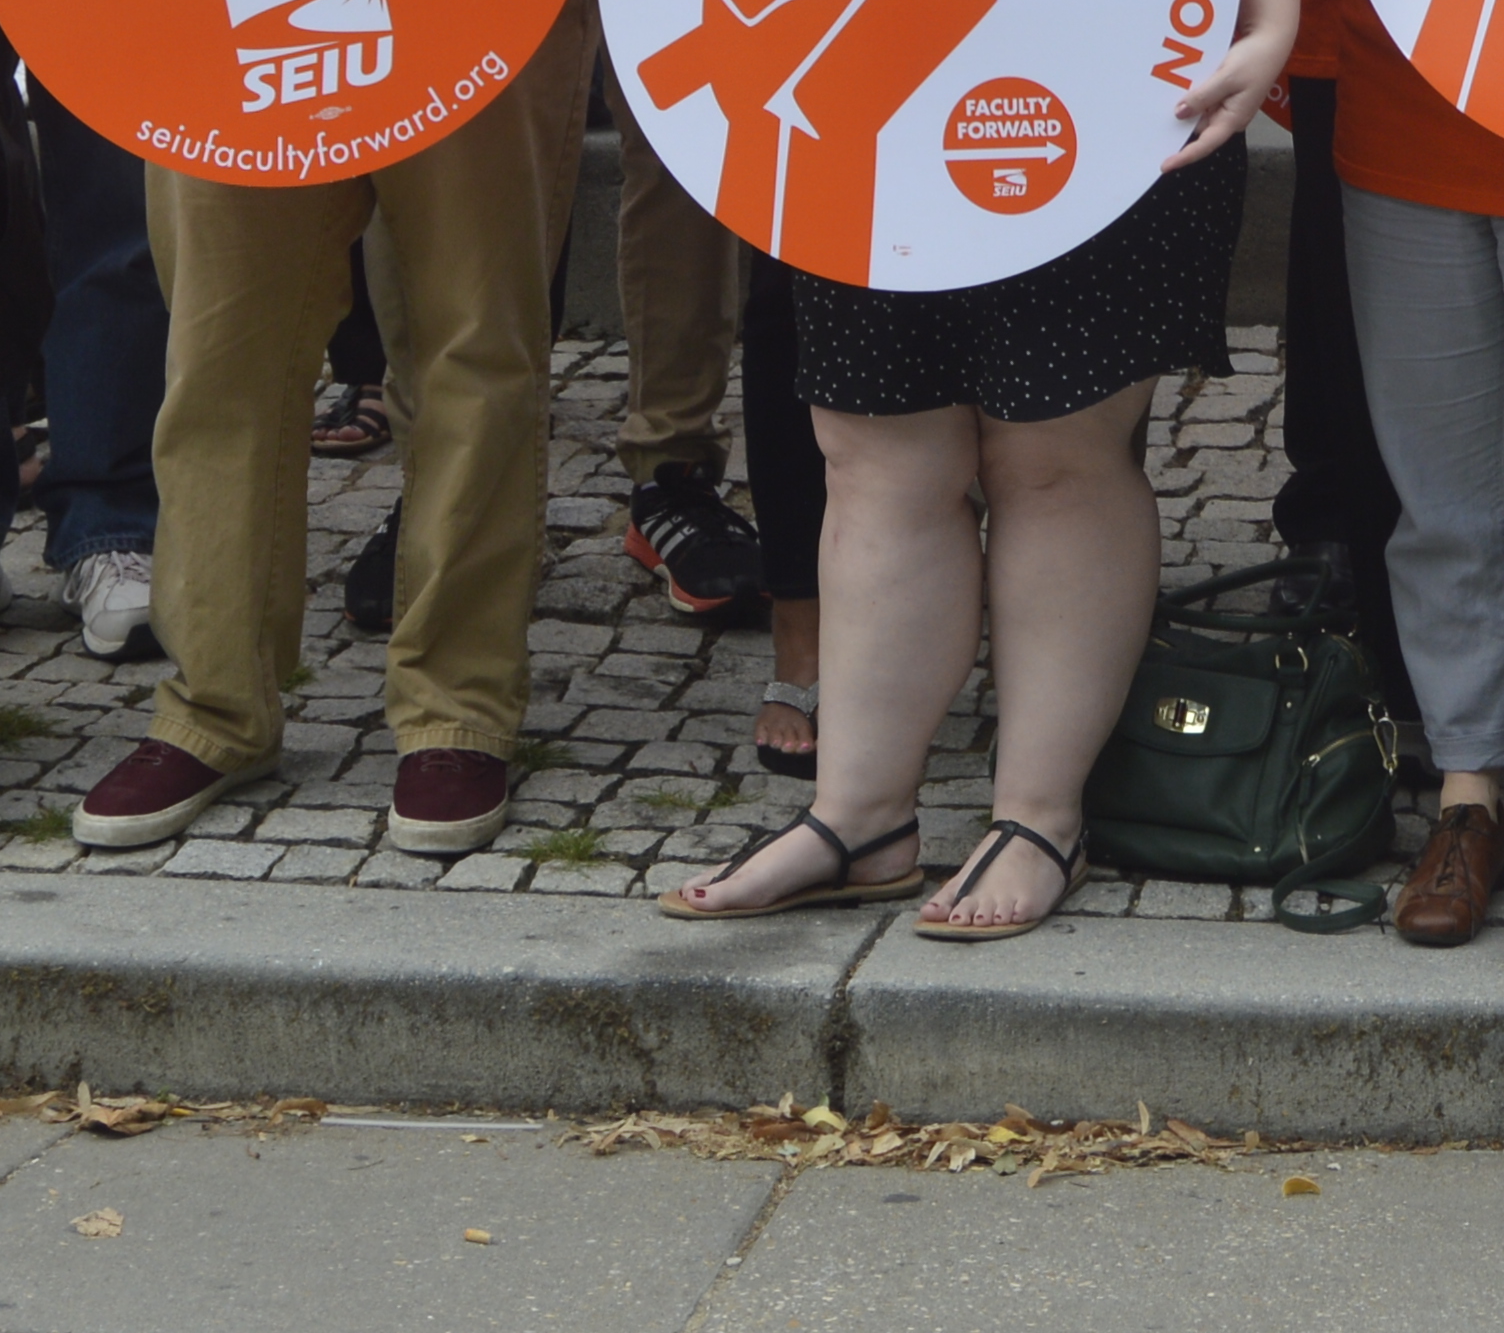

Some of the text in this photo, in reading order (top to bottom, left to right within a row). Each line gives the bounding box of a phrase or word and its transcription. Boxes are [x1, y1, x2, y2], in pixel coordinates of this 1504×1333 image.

[241, 34, 394, 114] SEIU
[136, 51, 509, 177] seiufacultyforward.org
[965, 97, 1051, 117] FACULTY
[957, 119, 1062, 139] FORWARD
[993, 185, 1027, 197] SEIU
